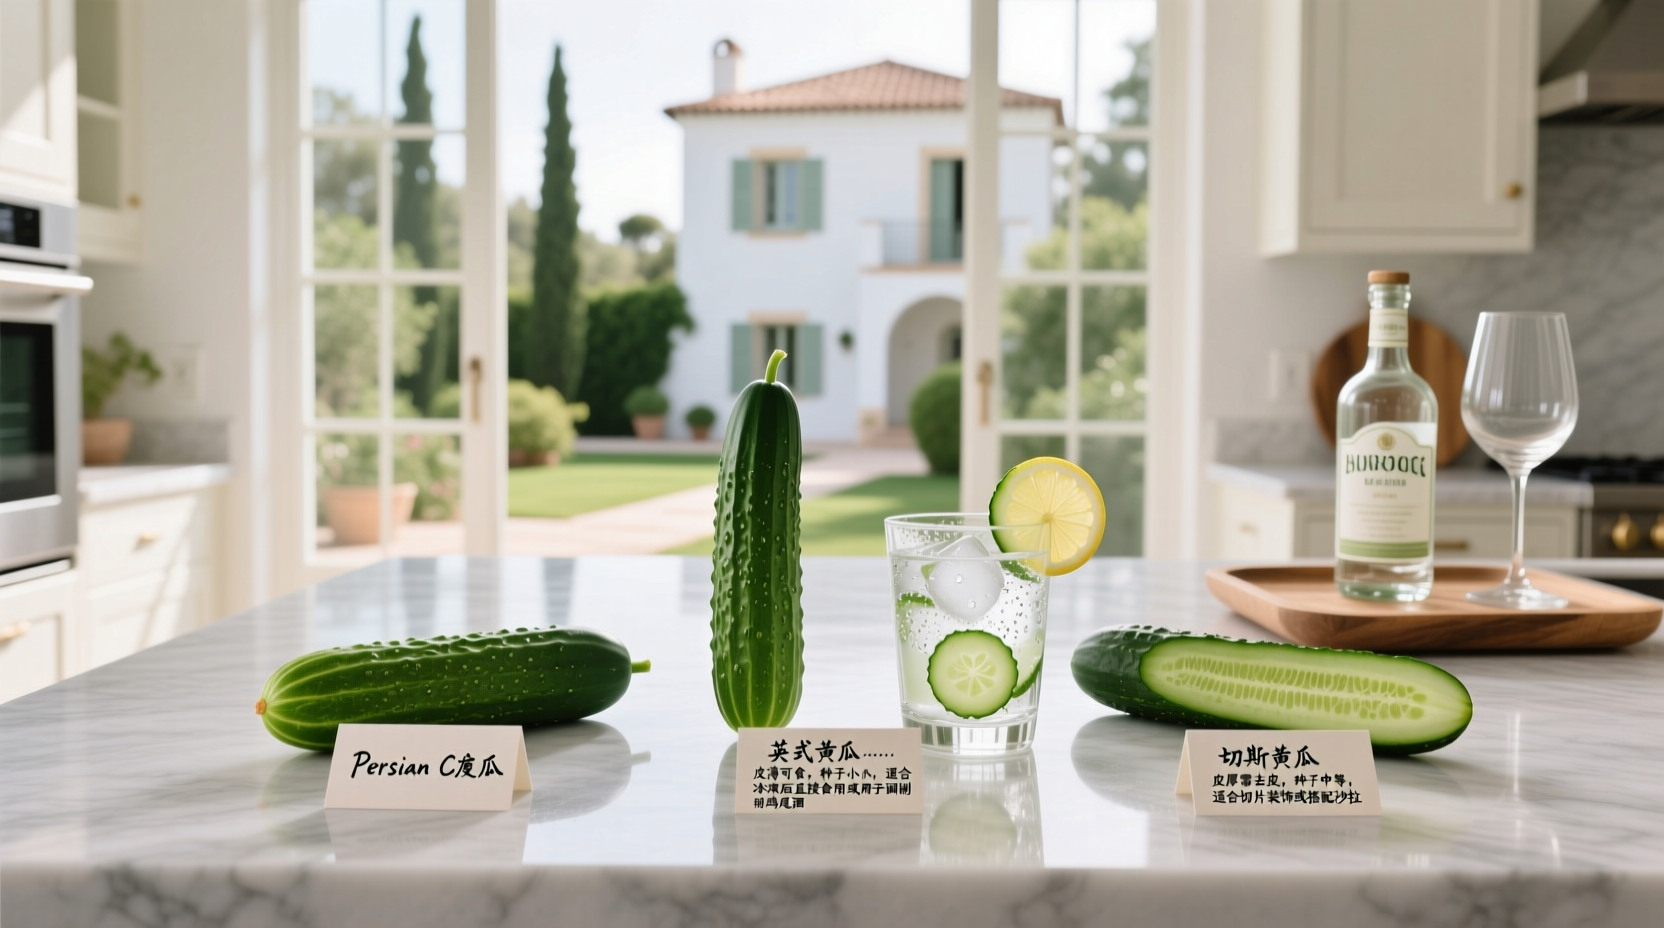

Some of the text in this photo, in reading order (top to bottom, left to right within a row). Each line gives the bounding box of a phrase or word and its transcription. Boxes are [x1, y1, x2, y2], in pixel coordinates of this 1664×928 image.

[351, 751, 429, 778] Persian
[1218, 744, 1319, 769] 切斯黄瓜
